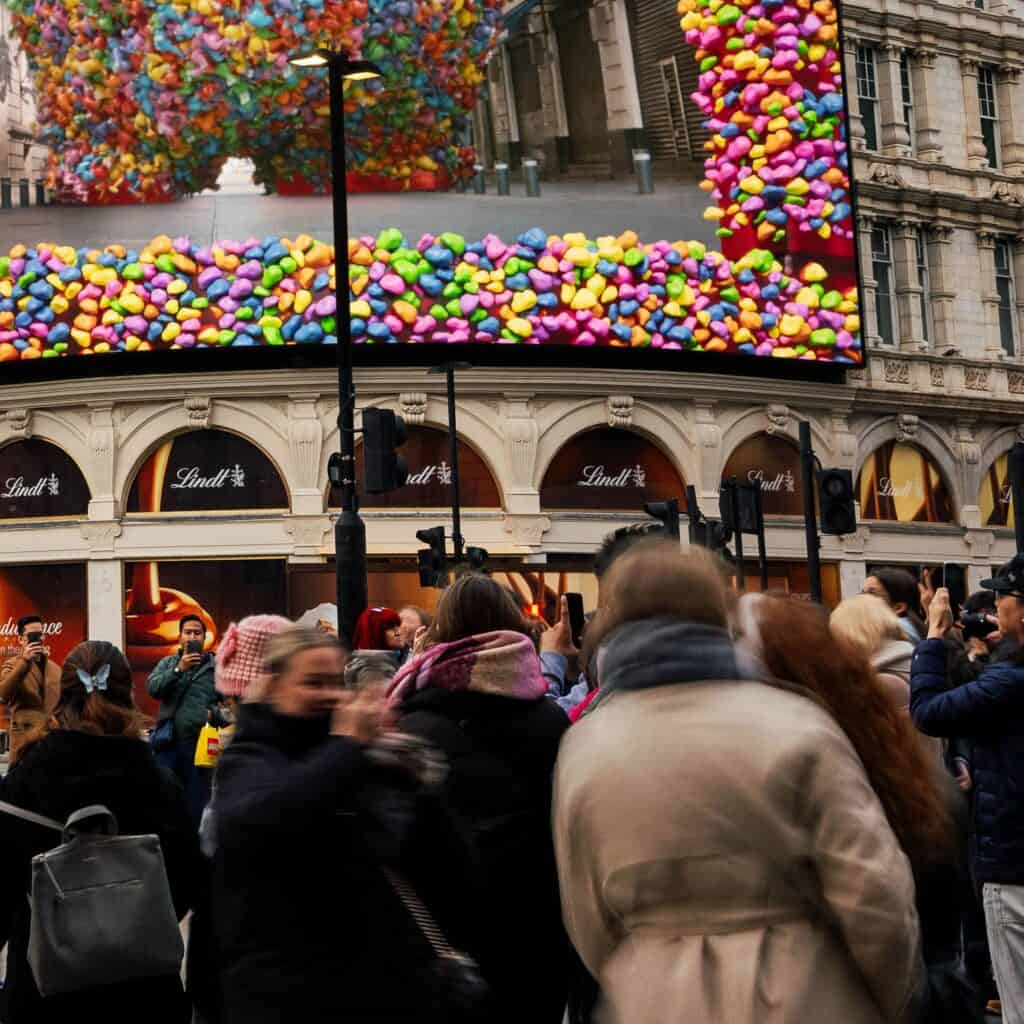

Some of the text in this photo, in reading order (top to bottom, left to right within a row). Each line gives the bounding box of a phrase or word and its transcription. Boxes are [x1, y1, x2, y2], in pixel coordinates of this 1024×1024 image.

[0, 475, 48, 498] Lindt
[170, 465, 231, 489] Lindt
[576, 464, 633, 487] Lindt
